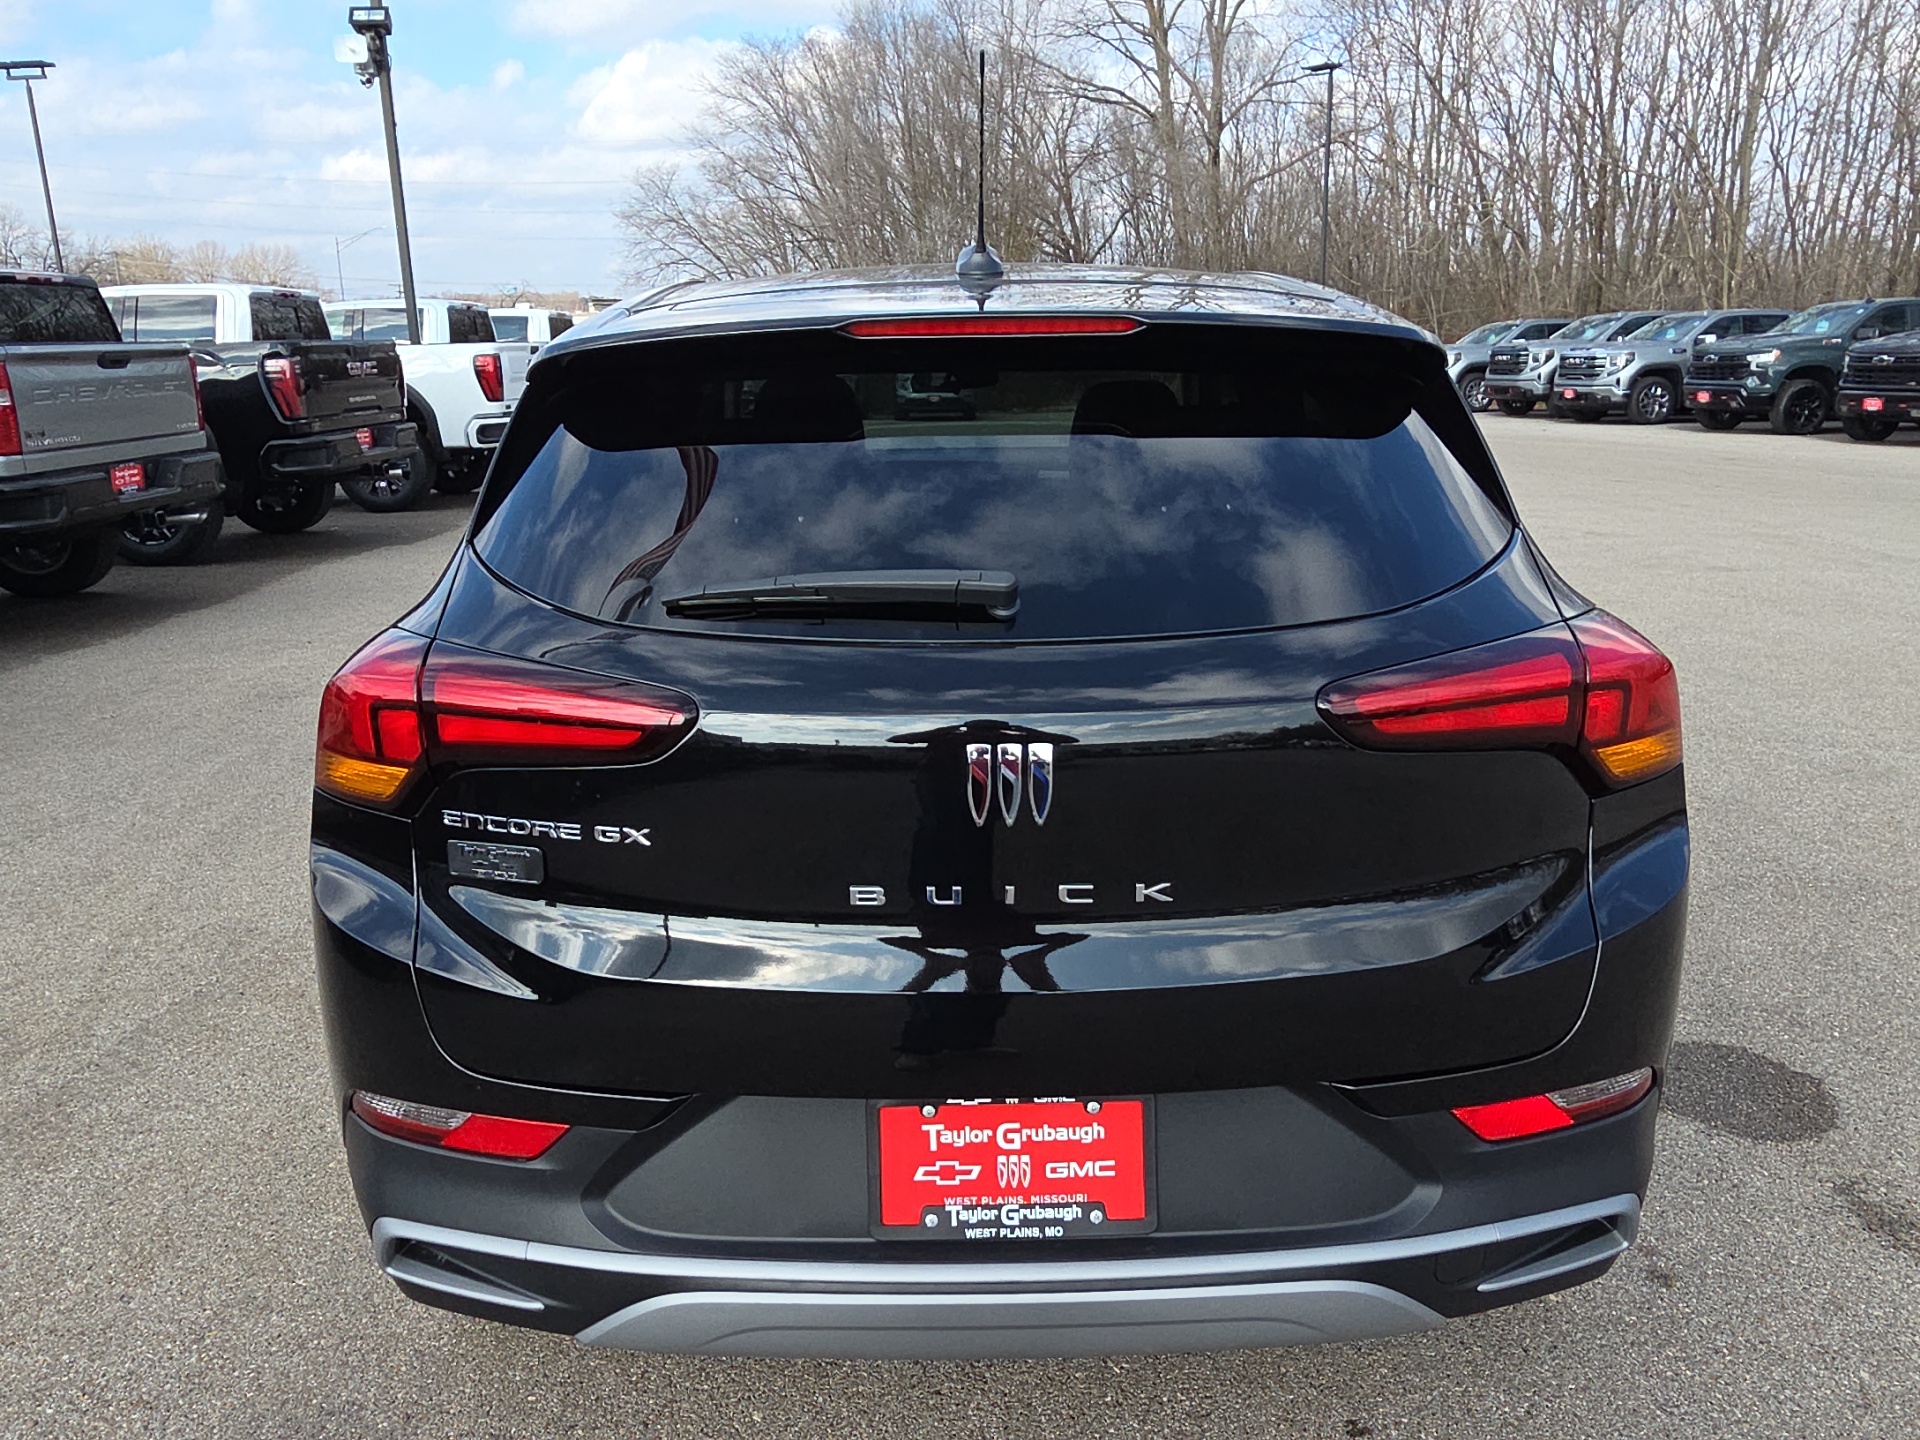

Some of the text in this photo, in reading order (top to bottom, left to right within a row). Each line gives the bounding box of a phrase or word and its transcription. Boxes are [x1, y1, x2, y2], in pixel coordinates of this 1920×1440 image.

[441, 809, 652, 846] ENCORE GX
[849, 882, 1174, 906] BUICK
[921, 1122, 1106, 1152] Taylor Grubaugh
[1045, 1160, 1116, 1179] GMC
[943, 1196, 978, 1206] WEST
[1030, 1193, 1088, 1204] MISSOURI
[944, 1204, 1082, 1227] Taylor Grubaugh
[964, 1226, 1064, 1239] WEST PLAINS, MO
